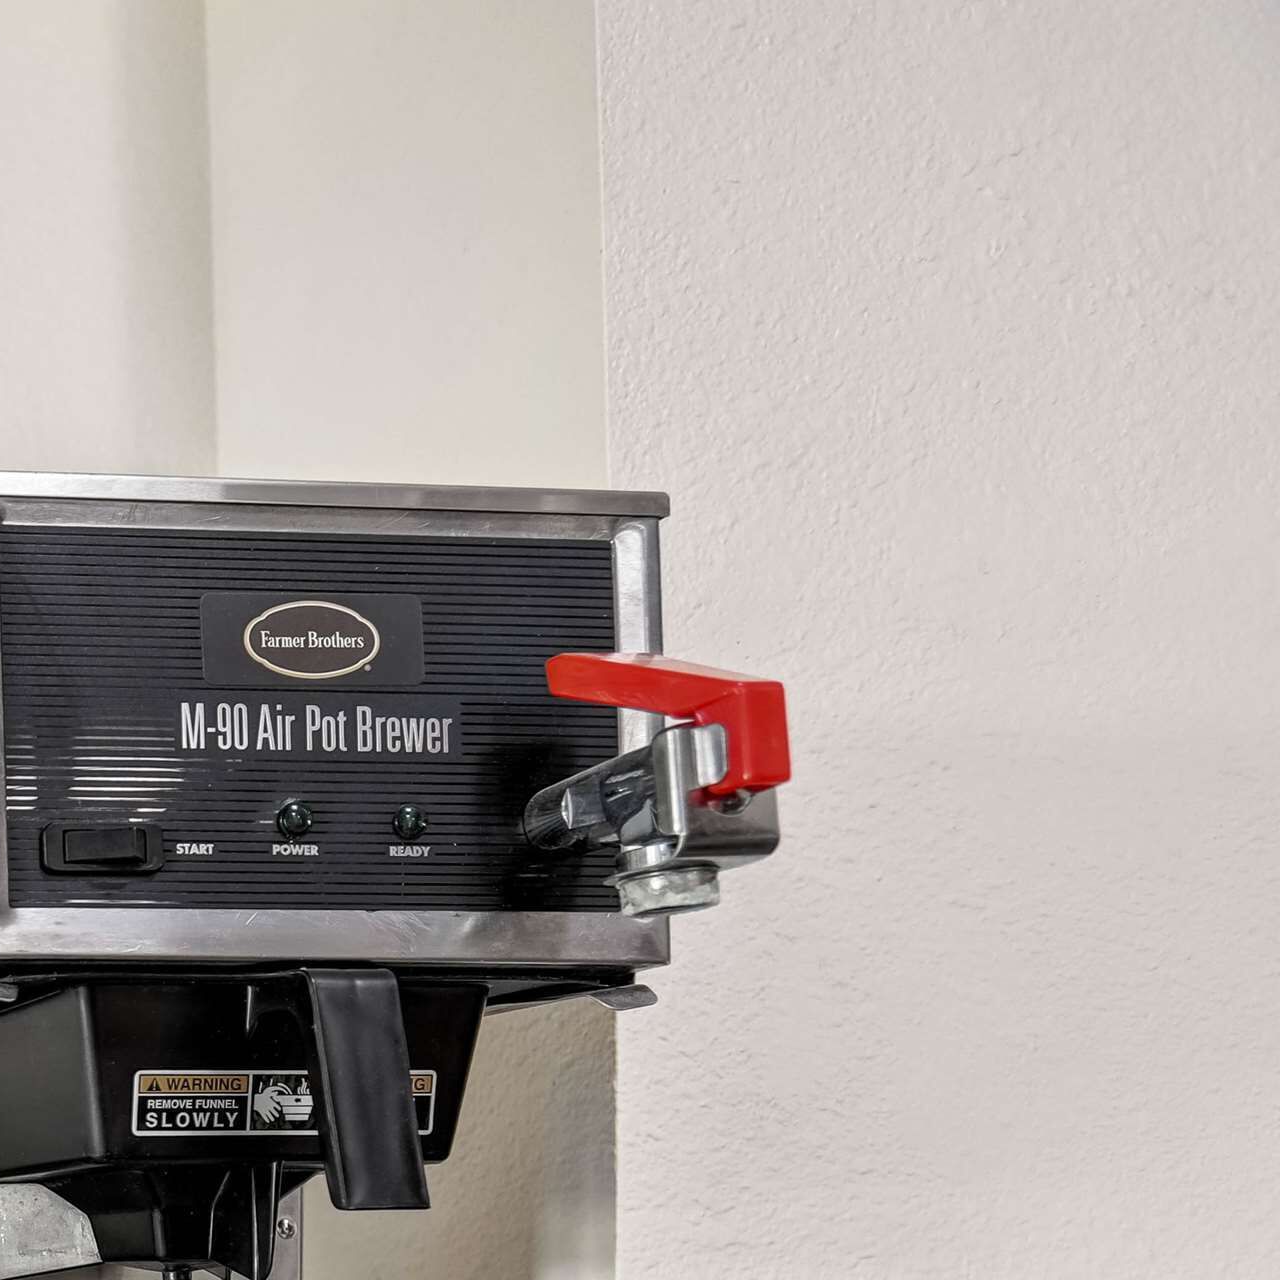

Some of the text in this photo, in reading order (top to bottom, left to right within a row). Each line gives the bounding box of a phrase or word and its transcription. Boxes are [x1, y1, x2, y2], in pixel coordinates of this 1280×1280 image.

[260, 630, 365, 649] Farmer Brothers
[180, 702, 452, 754] M-90 Air Pot Brewer
[176, 843, 215, 856] START
[272, 844, 319, 857] POWER
[389, 845, 432, 858] READY
[166, 1077, 242, 1092] WARNING
[147, 1099, 239, 1110] REMOVE FUNNEL
[145, 1111, 239, 1128] SLOWLY
